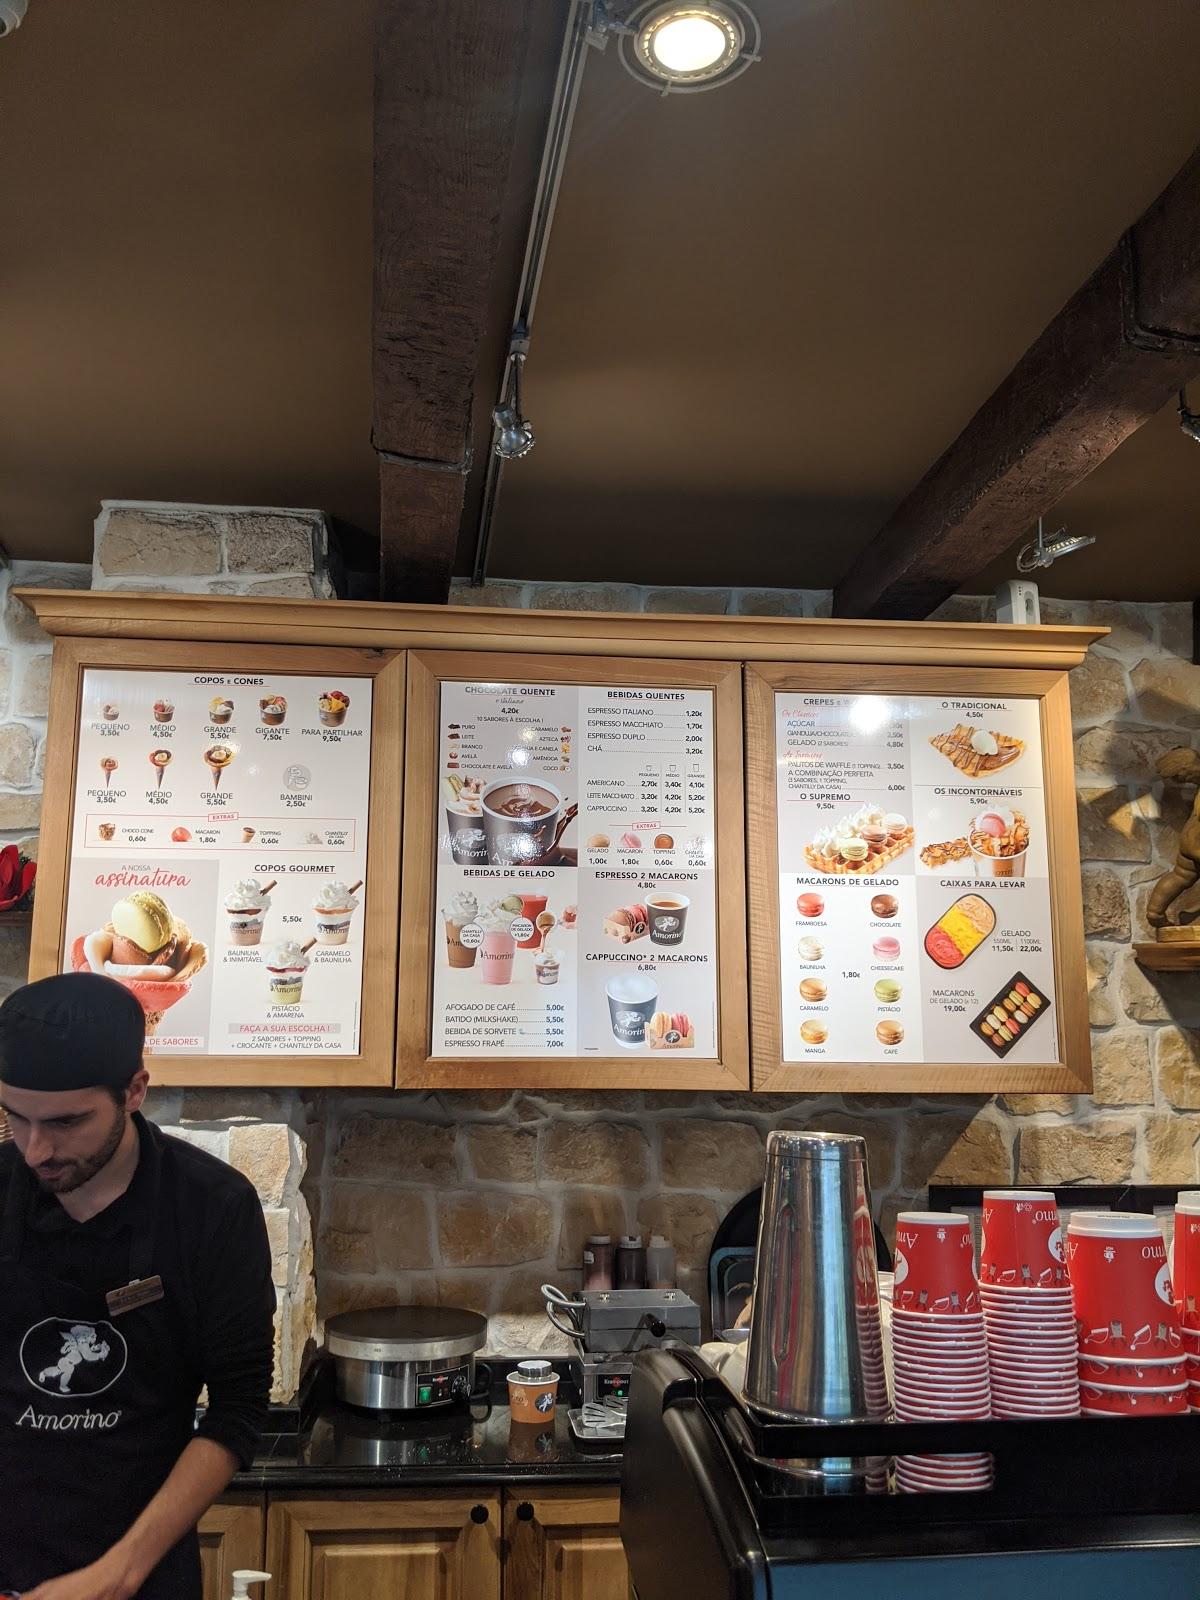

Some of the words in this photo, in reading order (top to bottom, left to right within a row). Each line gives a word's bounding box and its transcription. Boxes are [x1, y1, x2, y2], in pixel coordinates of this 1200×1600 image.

[520, 688, 555, 696] QUENTE
[646, 692, 684, 700] QUENTES
[588, 744, 602, 752] CHÁ
[948, 787, 1022, 796] INCONTORNÁVEIS
[95, 868, 191, 888] assinatura
[16, 1405, 119, 1431] Amorino
